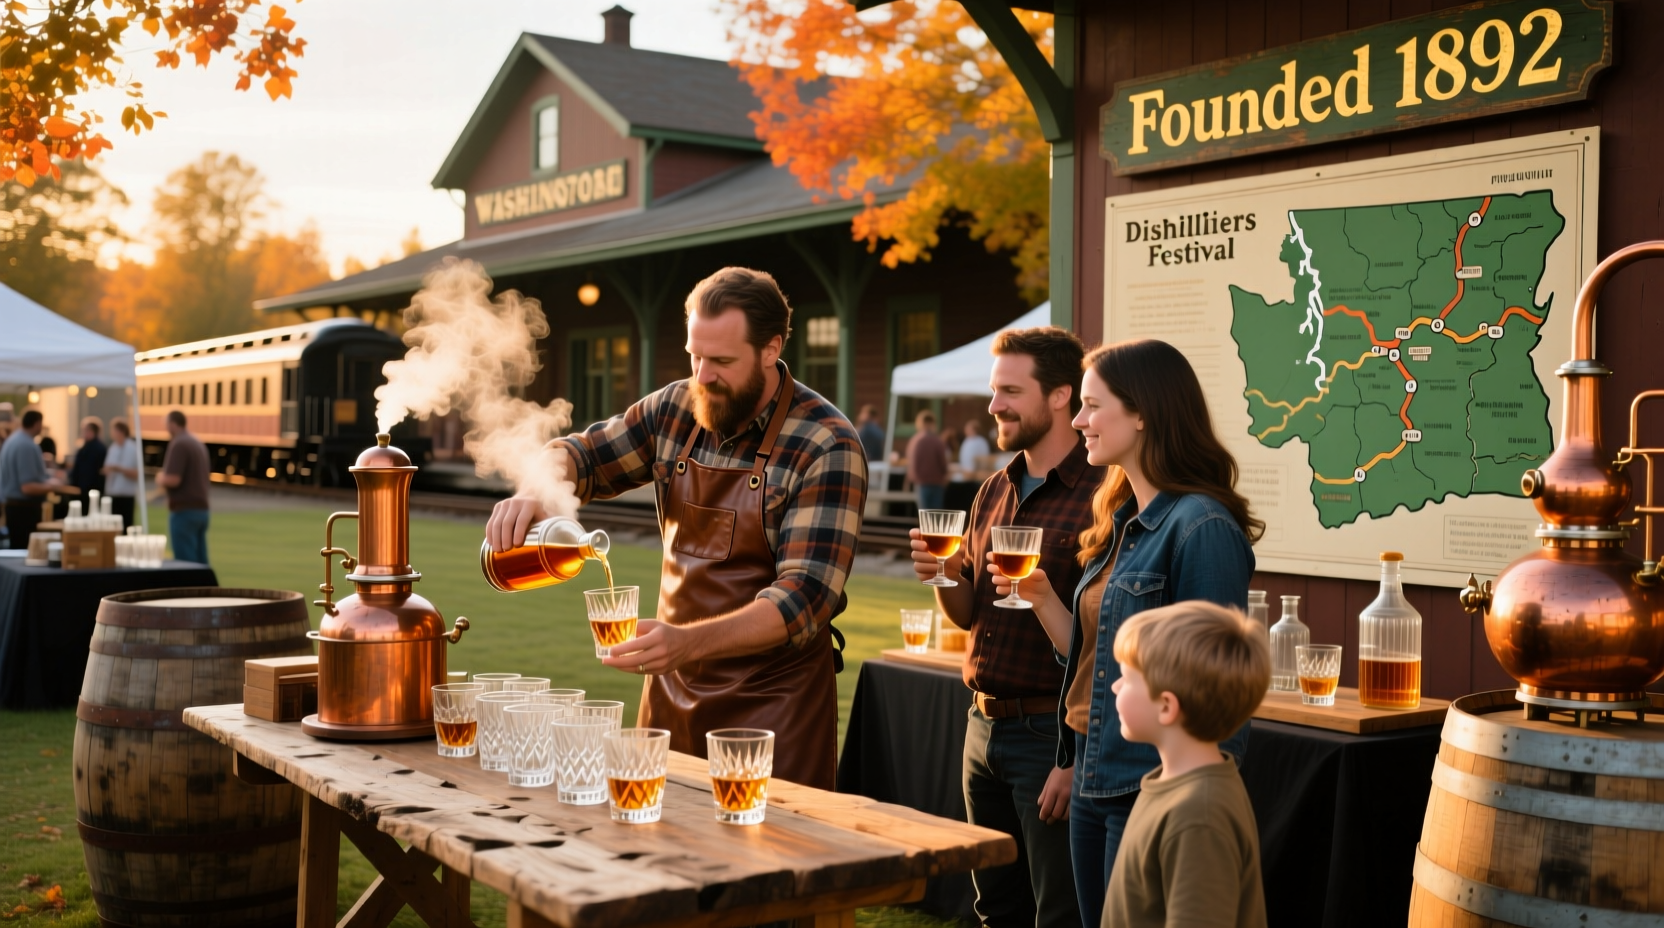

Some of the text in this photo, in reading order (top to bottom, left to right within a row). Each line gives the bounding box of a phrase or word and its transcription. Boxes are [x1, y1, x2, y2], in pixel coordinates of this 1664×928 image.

[1127, 8, 1563, 156] Founded 1892
[1147, 237, 1235, 267] Festival
